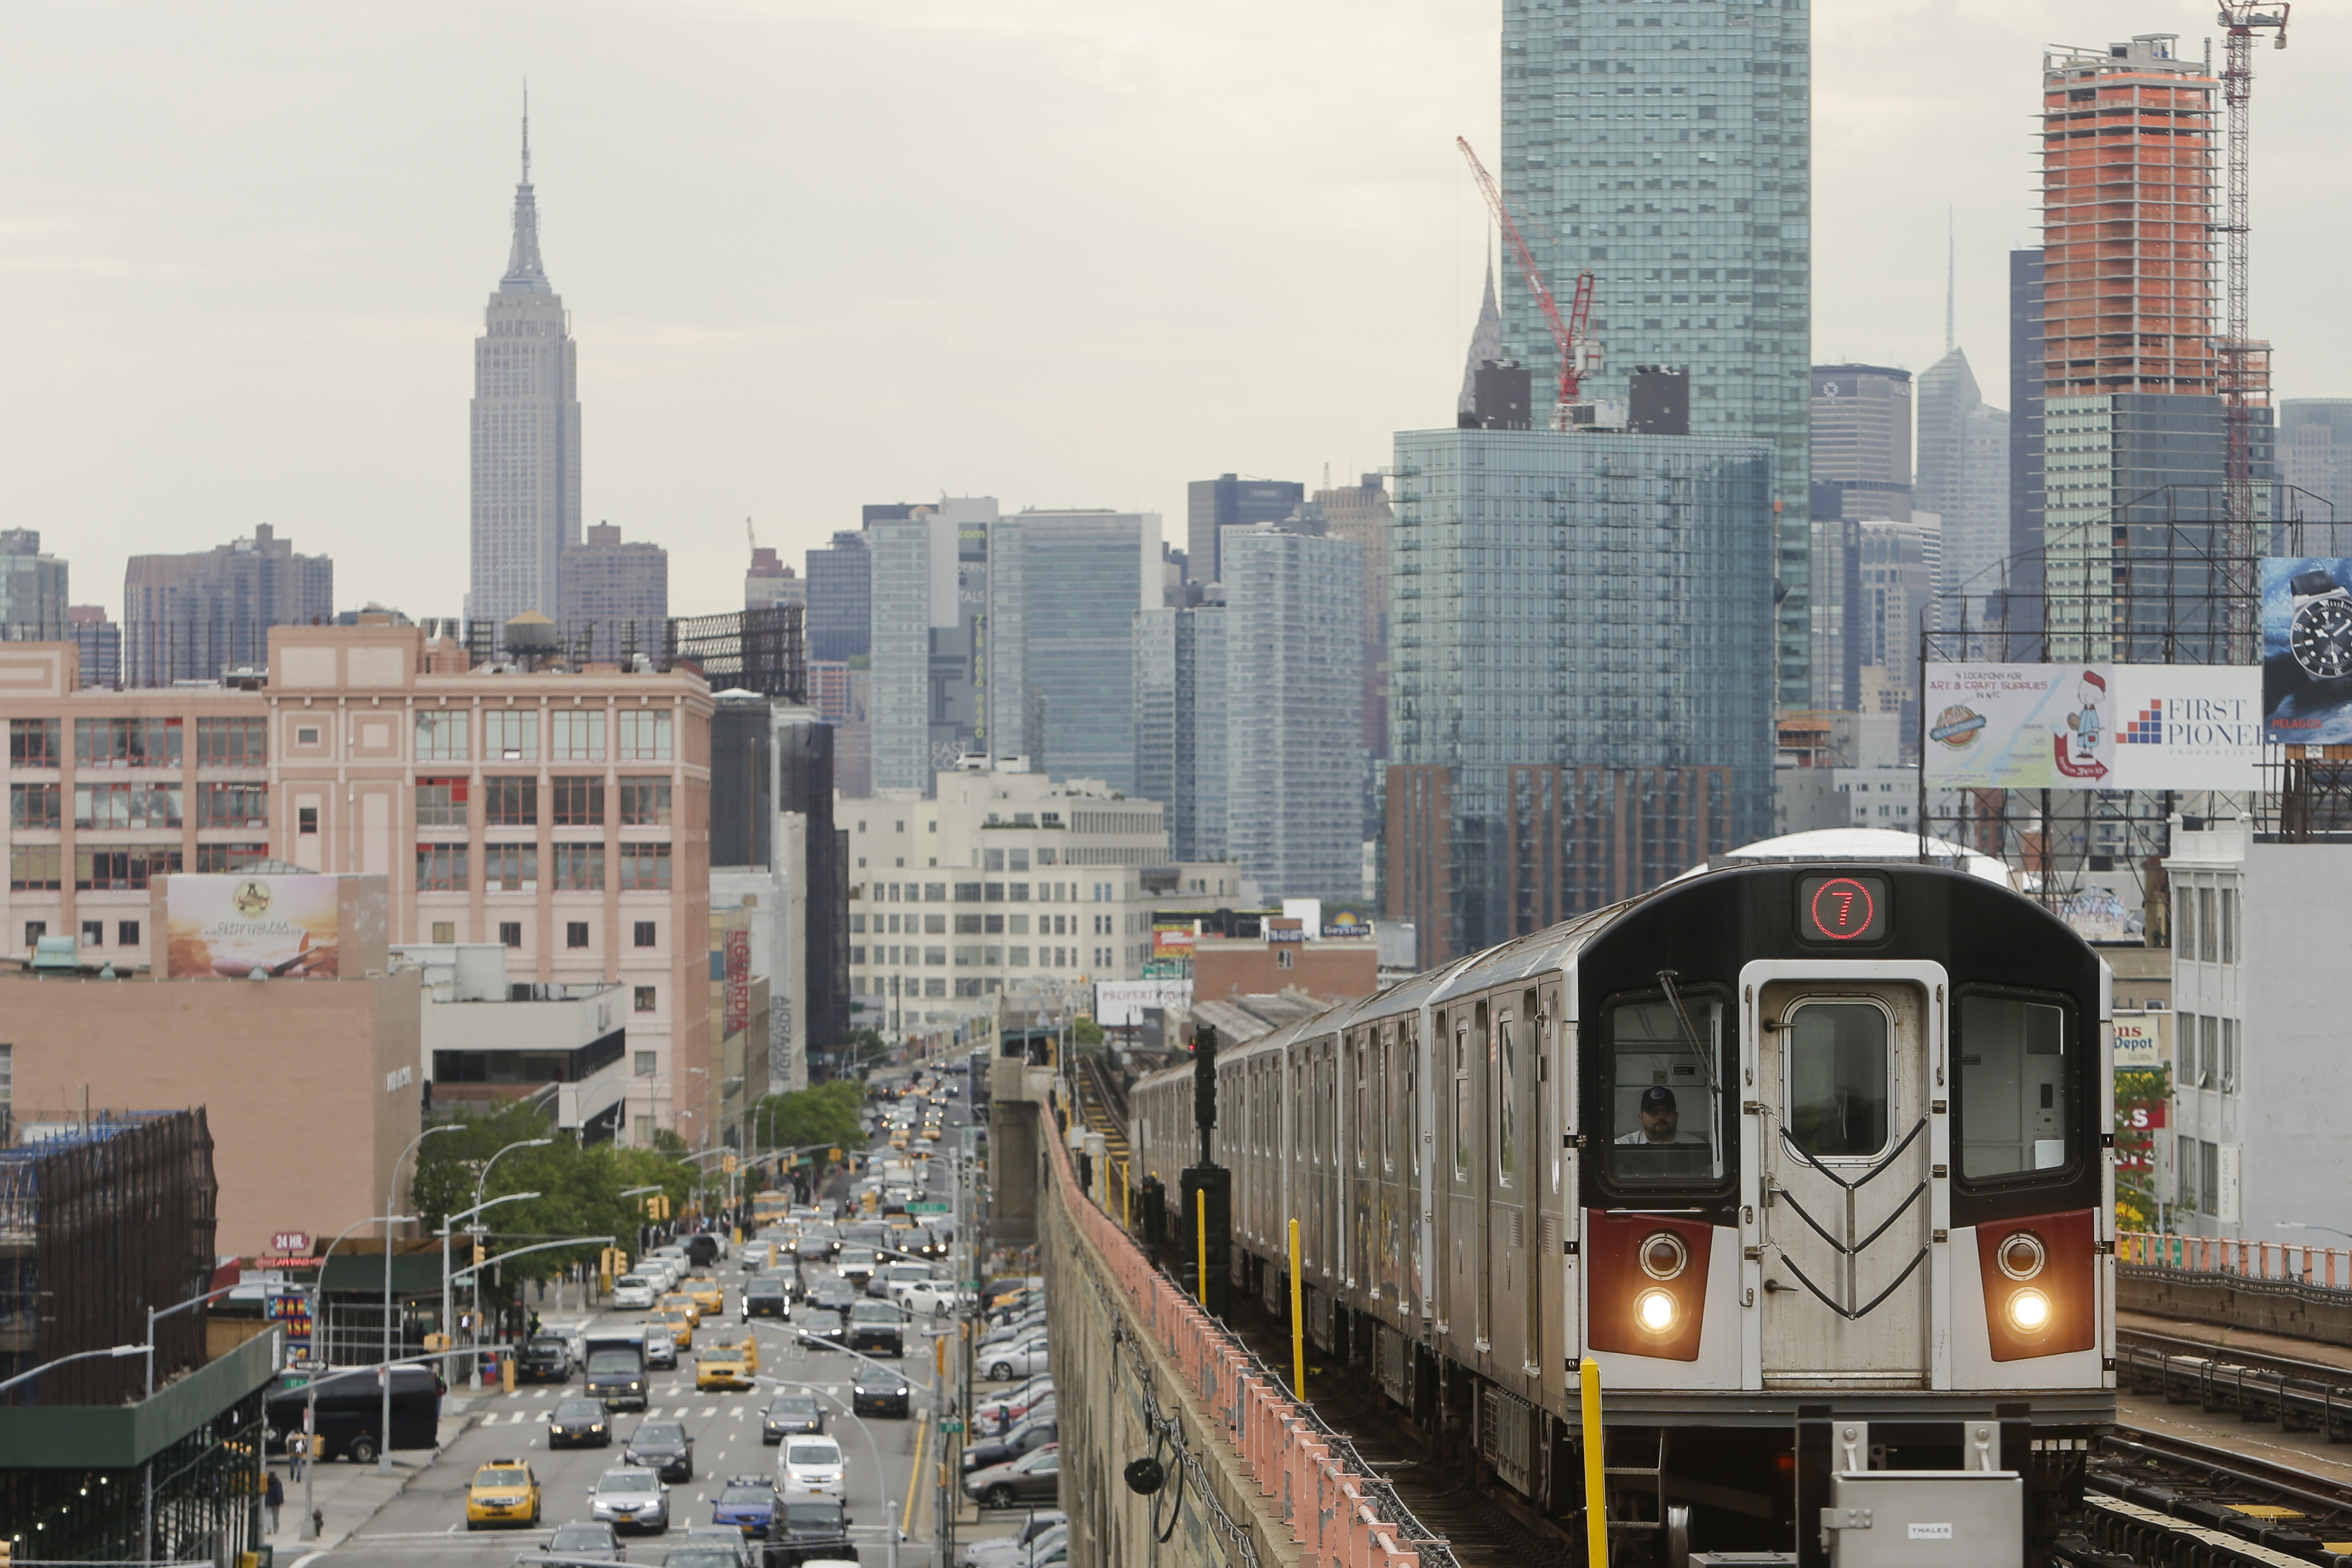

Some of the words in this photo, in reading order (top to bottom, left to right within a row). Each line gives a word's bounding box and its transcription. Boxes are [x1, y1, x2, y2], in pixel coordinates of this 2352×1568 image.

[959, 590, 985, 603] TALS
[1964, 672, 2005, 680] LOCATIONS
[2006, 672, 2023, 680] FOR
[1930, 681, 1951, 691] ART
[1965, 681, 1997, 691] CRAFT
[2000, 681, 2049, 690] SUPPLIES
[2168, 698, 2247, 721] FIRST
[2272, 719, 2322, 729] PELAGOS
[931, 741, 968, 756] EAST
[931, 756, 958, 771] CO
[1832, 892, 1853, 926] 7
[2114, 1037, 2153, 1051] Depot
[276, 1233, 288, 1250] 24
[276, 1298, 306, 1317] CAR
[286, 1318, 312, 1336] ASH
